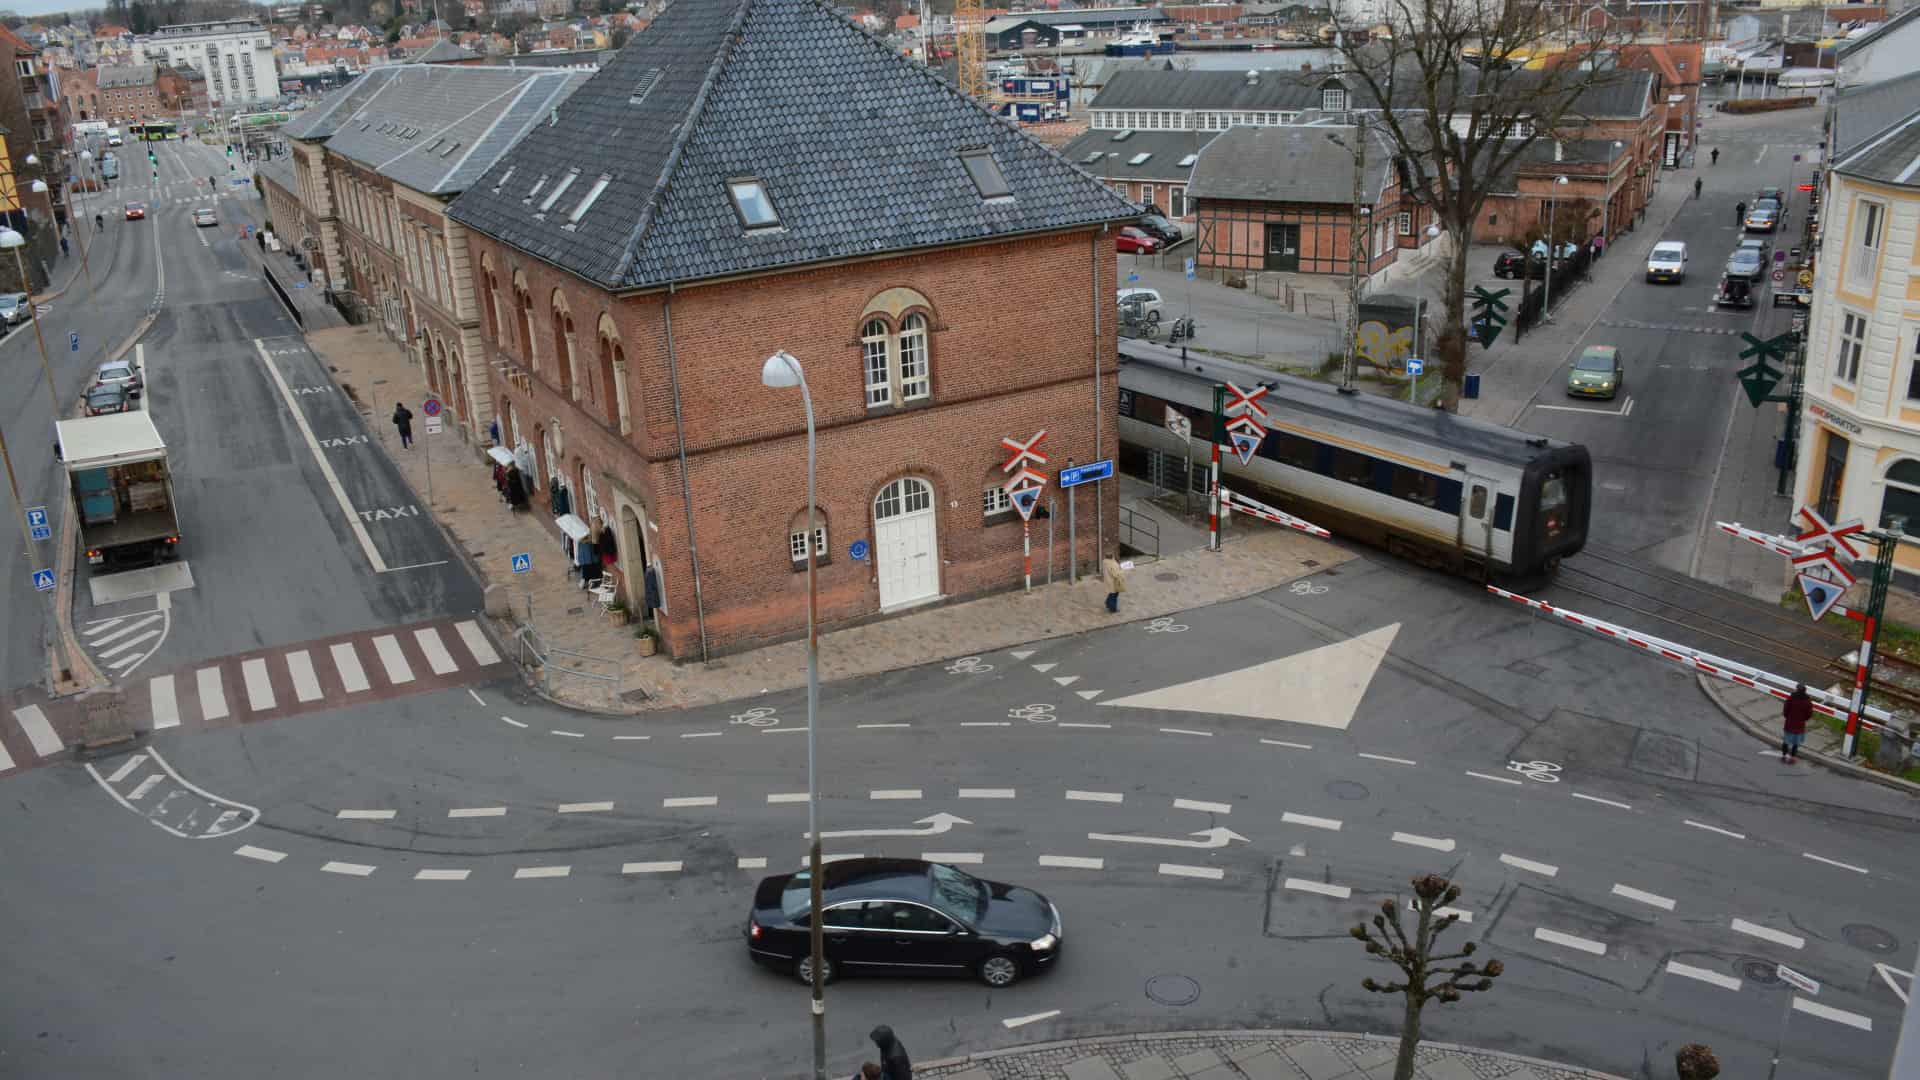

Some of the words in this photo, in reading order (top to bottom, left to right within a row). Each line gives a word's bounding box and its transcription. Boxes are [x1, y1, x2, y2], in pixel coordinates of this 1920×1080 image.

[270, 348, 306, 356] TAXI
[290, 385, 333, 395] TAXI
[320, 435, 368, 448] TAXI
[31, 511, 42, 525] P
[359, 505, 419, 523] TAXI
